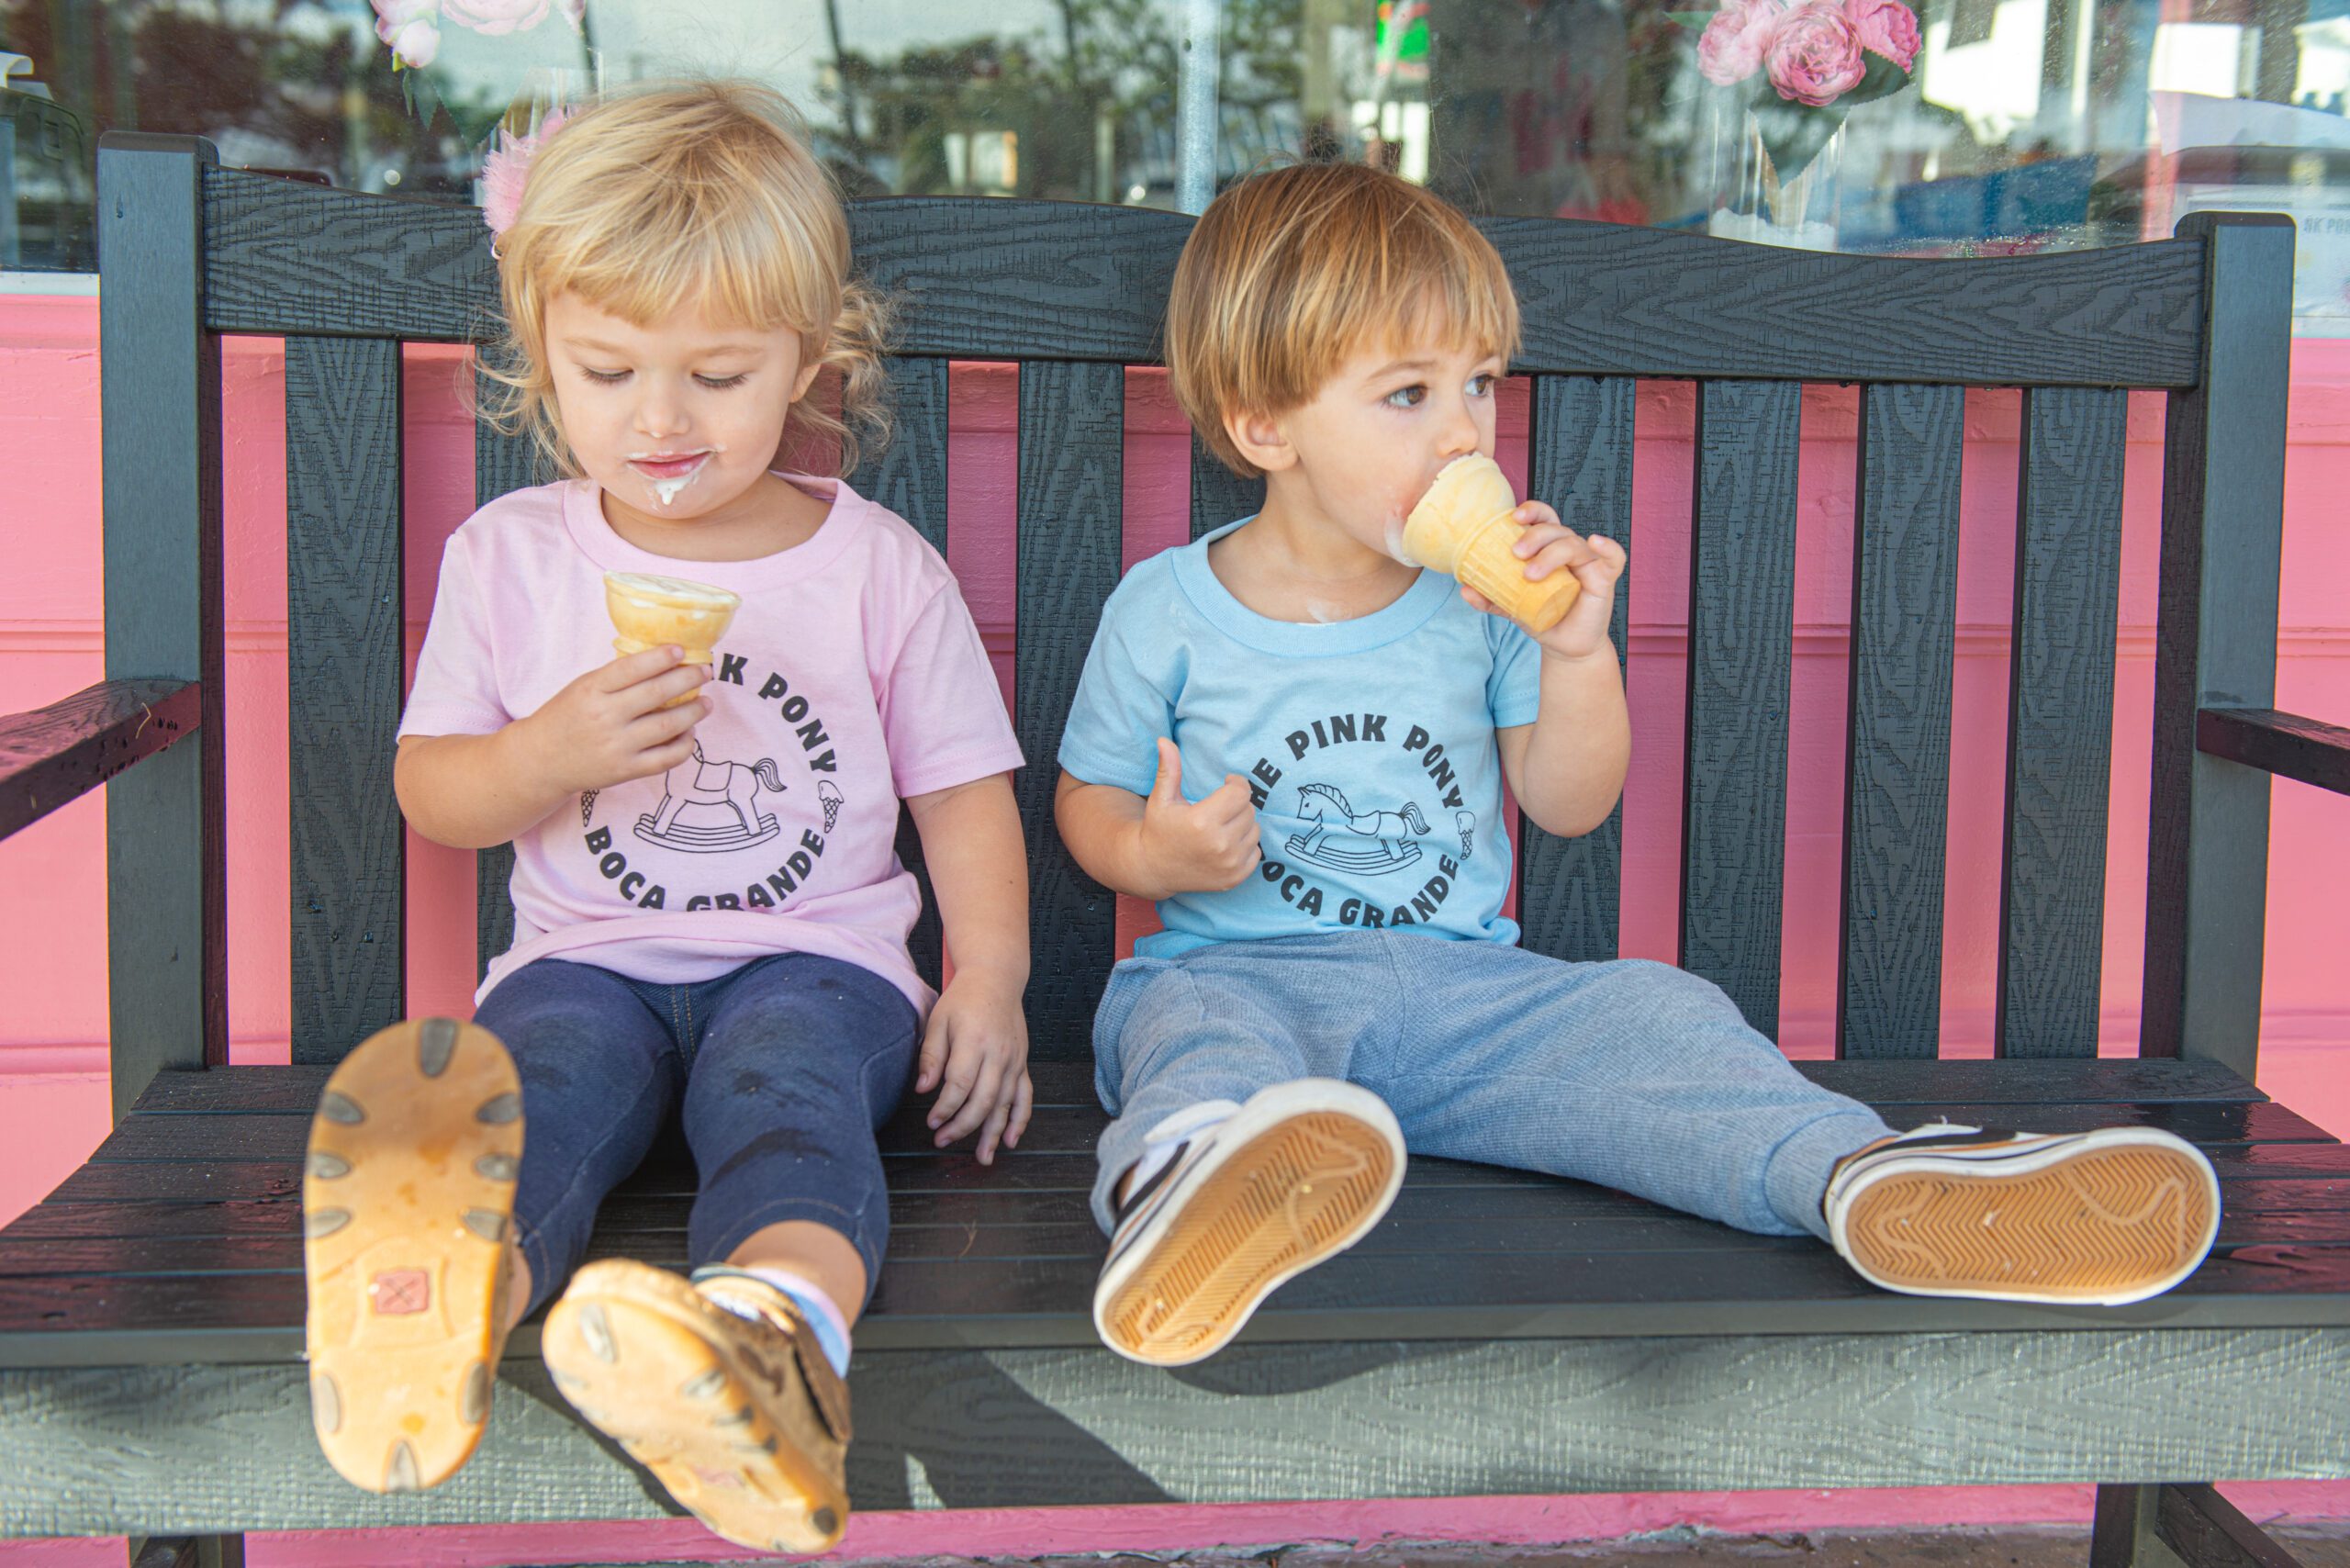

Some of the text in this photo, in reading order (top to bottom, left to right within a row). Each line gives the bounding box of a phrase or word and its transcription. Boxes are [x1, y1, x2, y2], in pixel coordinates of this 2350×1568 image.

[757, 672, 836, 772] PONY
[1248, 713, 1462, 811] HE PINK PONY
[585, 825, 824, 912] BOCA GRANDE
[1258, 842, 1459, 928] OCA GRANDE
